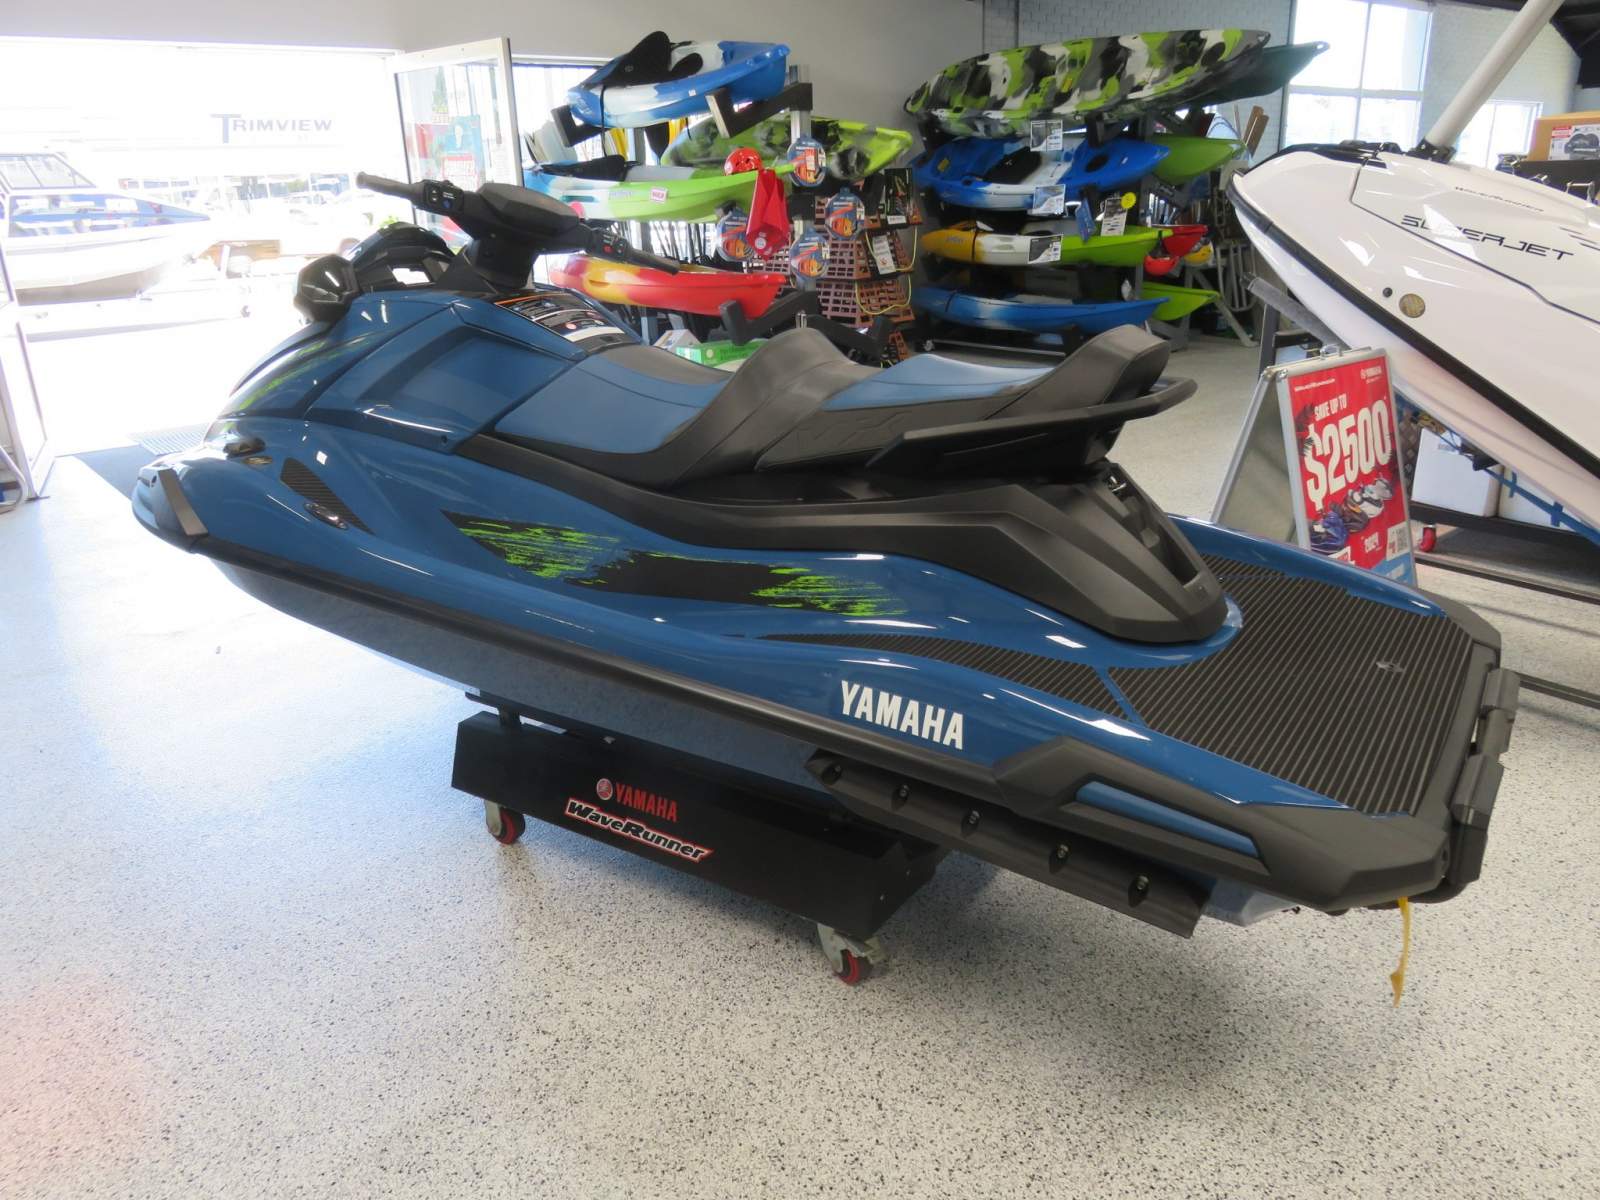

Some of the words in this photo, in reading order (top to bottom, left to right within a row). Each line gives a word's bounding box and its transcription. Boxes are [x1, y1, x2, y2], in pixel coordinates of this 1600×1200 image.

[209, 113, 333, 143] TRIMVIEW
[1313, 401, 1330, 421] SAVE
[1329, 397, 1339, 415] UP
[1338, 392, 1347, 411] TO
[1304, 398, 1393, 514] $2500
[841, 680, 964, 750] YAMAHA
[615, 782, 679, 823] YAMAHA
[566, 799, 710, 861] WaveRunner
